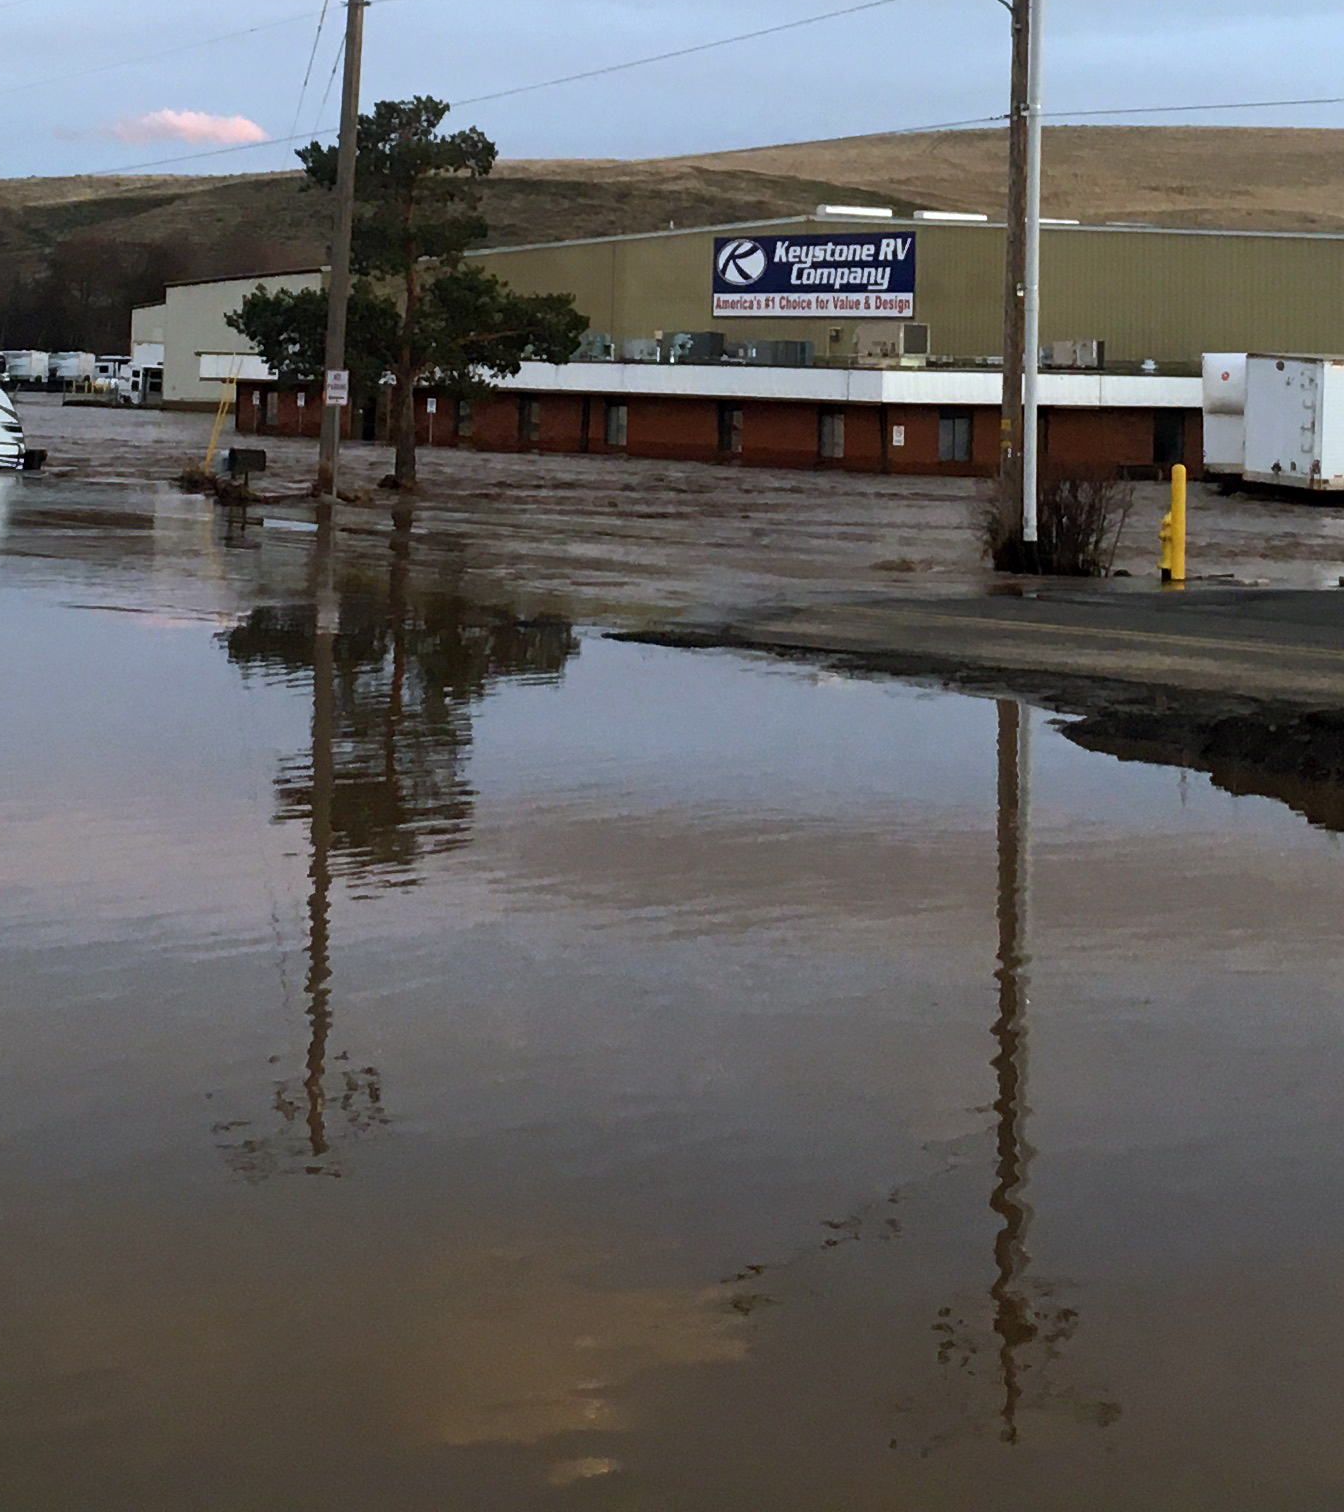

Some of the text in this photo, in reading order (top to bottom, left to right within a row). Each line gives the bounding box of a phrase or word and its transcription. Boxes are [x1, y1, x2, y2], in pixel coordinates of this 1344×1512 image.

[773, 238, 912, 267] Keystone RV
[790, 265, 891, 290] Company
[716, 295, 911, 314] America's #1 Choice for Value & Design
